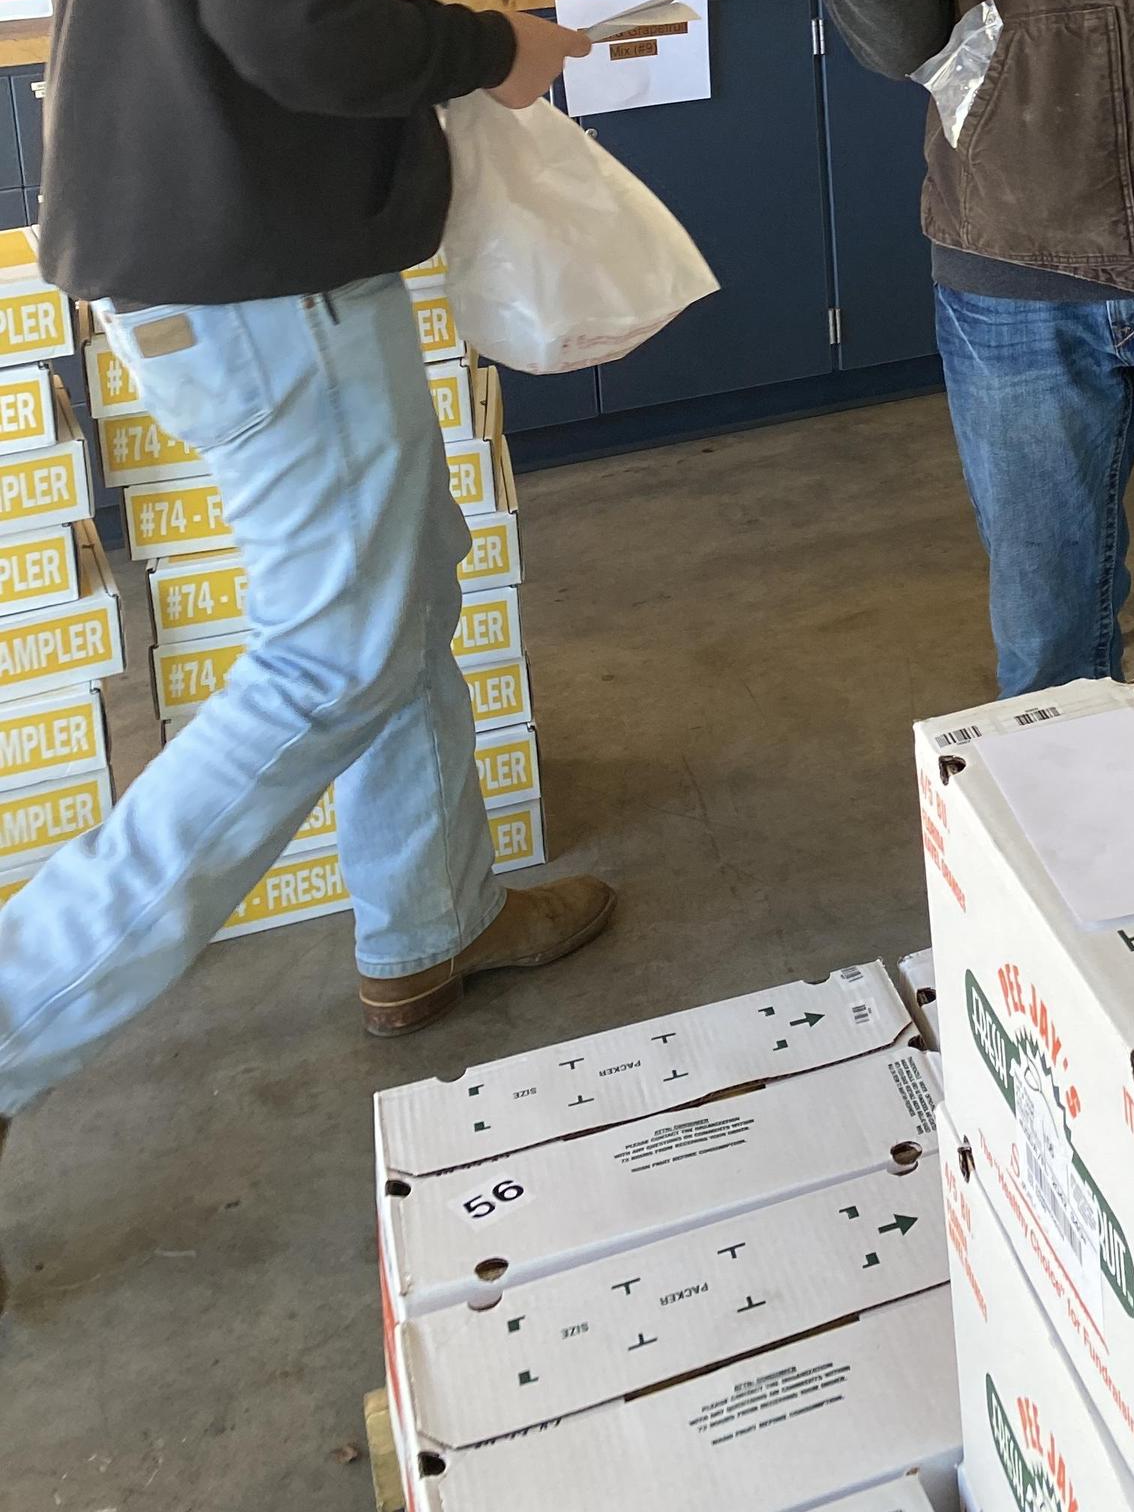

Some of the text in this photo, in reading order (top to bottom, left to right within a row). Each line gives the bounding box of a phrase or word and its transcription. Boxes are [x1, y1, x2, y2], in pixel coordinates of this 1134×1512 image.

[611, 42, 658, 57] Mix (#9)
[112, 422, 161, 463] #74
[140, 494, 188, 538] #74
[166, 580, 215, 621] #74
[169, 658, 217, 698] #74
[265, 862, 344, 910] FRESH
[997, 961, 1027, 1017] PEE
[598, 1059, 642, 1077] PACKER
[512, 1087, 537, 1100] SIZE
[462, 1179, 525, 1219] 56
[660, 1281, 709, 1307] PACKER
[561, 1322, 590, 1339] SIZE
